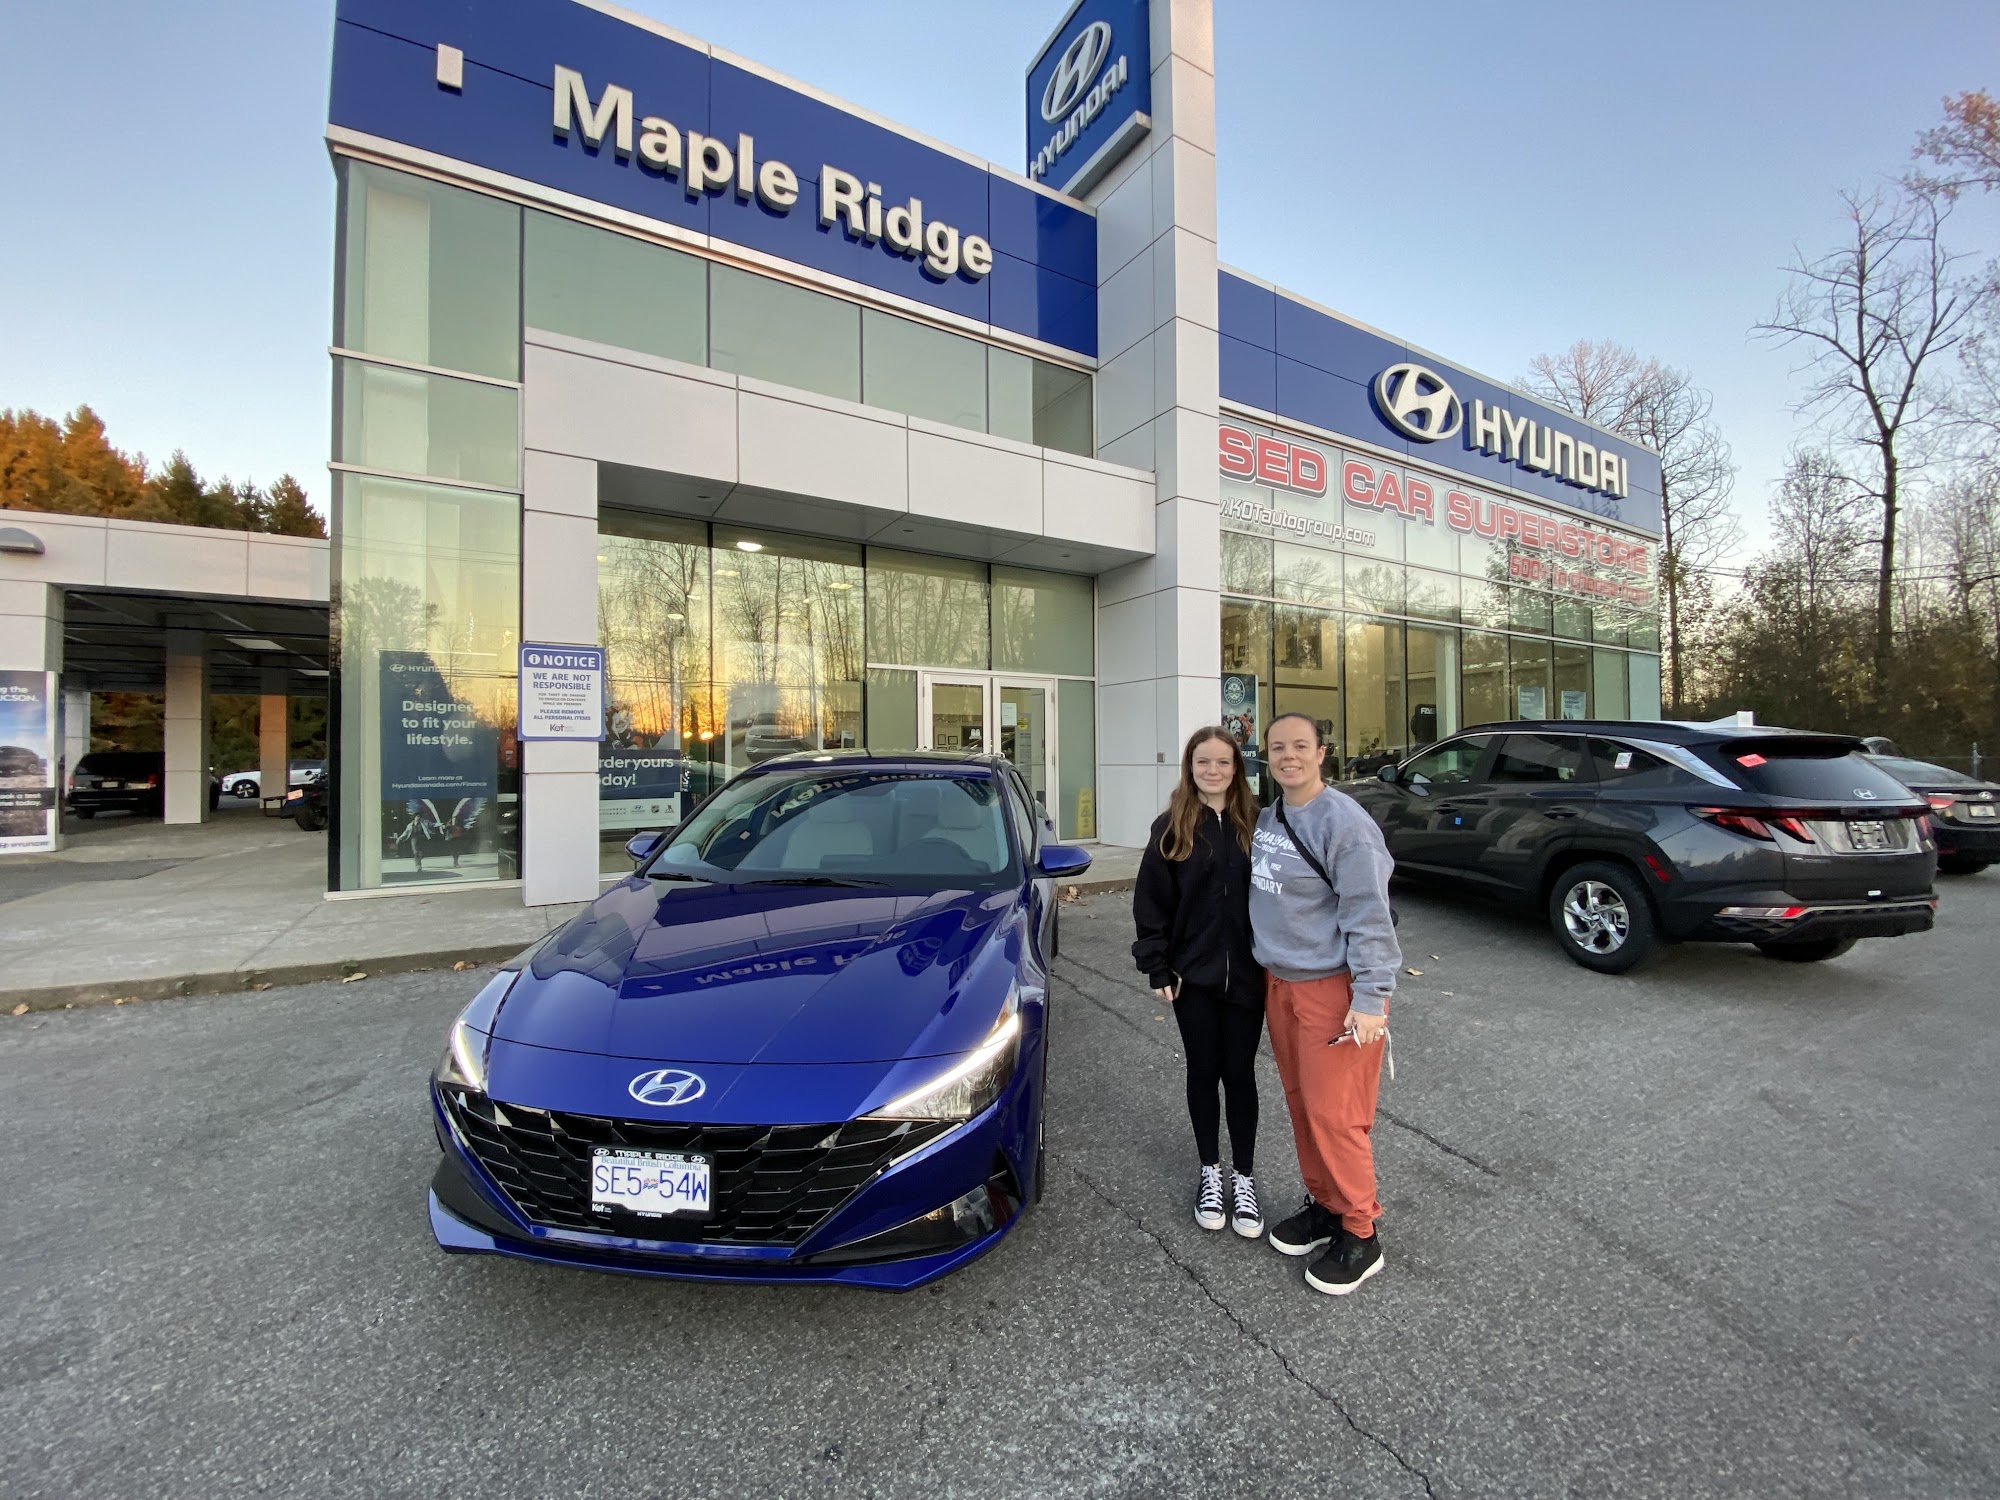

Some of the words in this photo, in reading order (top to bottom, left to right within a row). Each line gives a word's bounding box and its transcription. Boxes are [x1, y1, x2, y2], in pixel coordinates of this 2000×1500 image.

[1030, 55, 1127, 181] HYUNDAI
[553, 64, 799, 210] Maple
[818, 164, 992, 278] Ridge
[1470, 399, 1628, 499] HYUNDAI
[1219, 424, 1327, 498] SED
[1342, 458, 1434, 527] CAR
[1446, 489, 1648, 577] SUPERSTORE
[1510, 554, 1550, 580] 500+
[543, 654, 596, 668] NOTICE
[533, 672, 548, 680] WE
[551, 673, 569, 681] ARE
[573, 674, 592, 682] NOT
[533, 681, 592, 691] RESPONSIBLE
[401, 717, 419, 729] to
[422, 716, 440, 729] fit
[442, 719, 478, 731] your
[406, 733, 473, 747] lifestyle.
[599, 756, 631, 769] rder
[632, 758, 675, 771] yours
[599, 773, 637, 788] day!
[614, 1149, 652, 1160] MAPLE
[655, 1152, 684, 1162] RIDGE
[601, 1156, 635, 1166] Beautiful
[637, 1159, 662, 1168] British
[663, 1160, 702, 1171] Columbia
[595, 1165, 642, 1196] SE5
[659, 1170, 707, 1202] 54W
